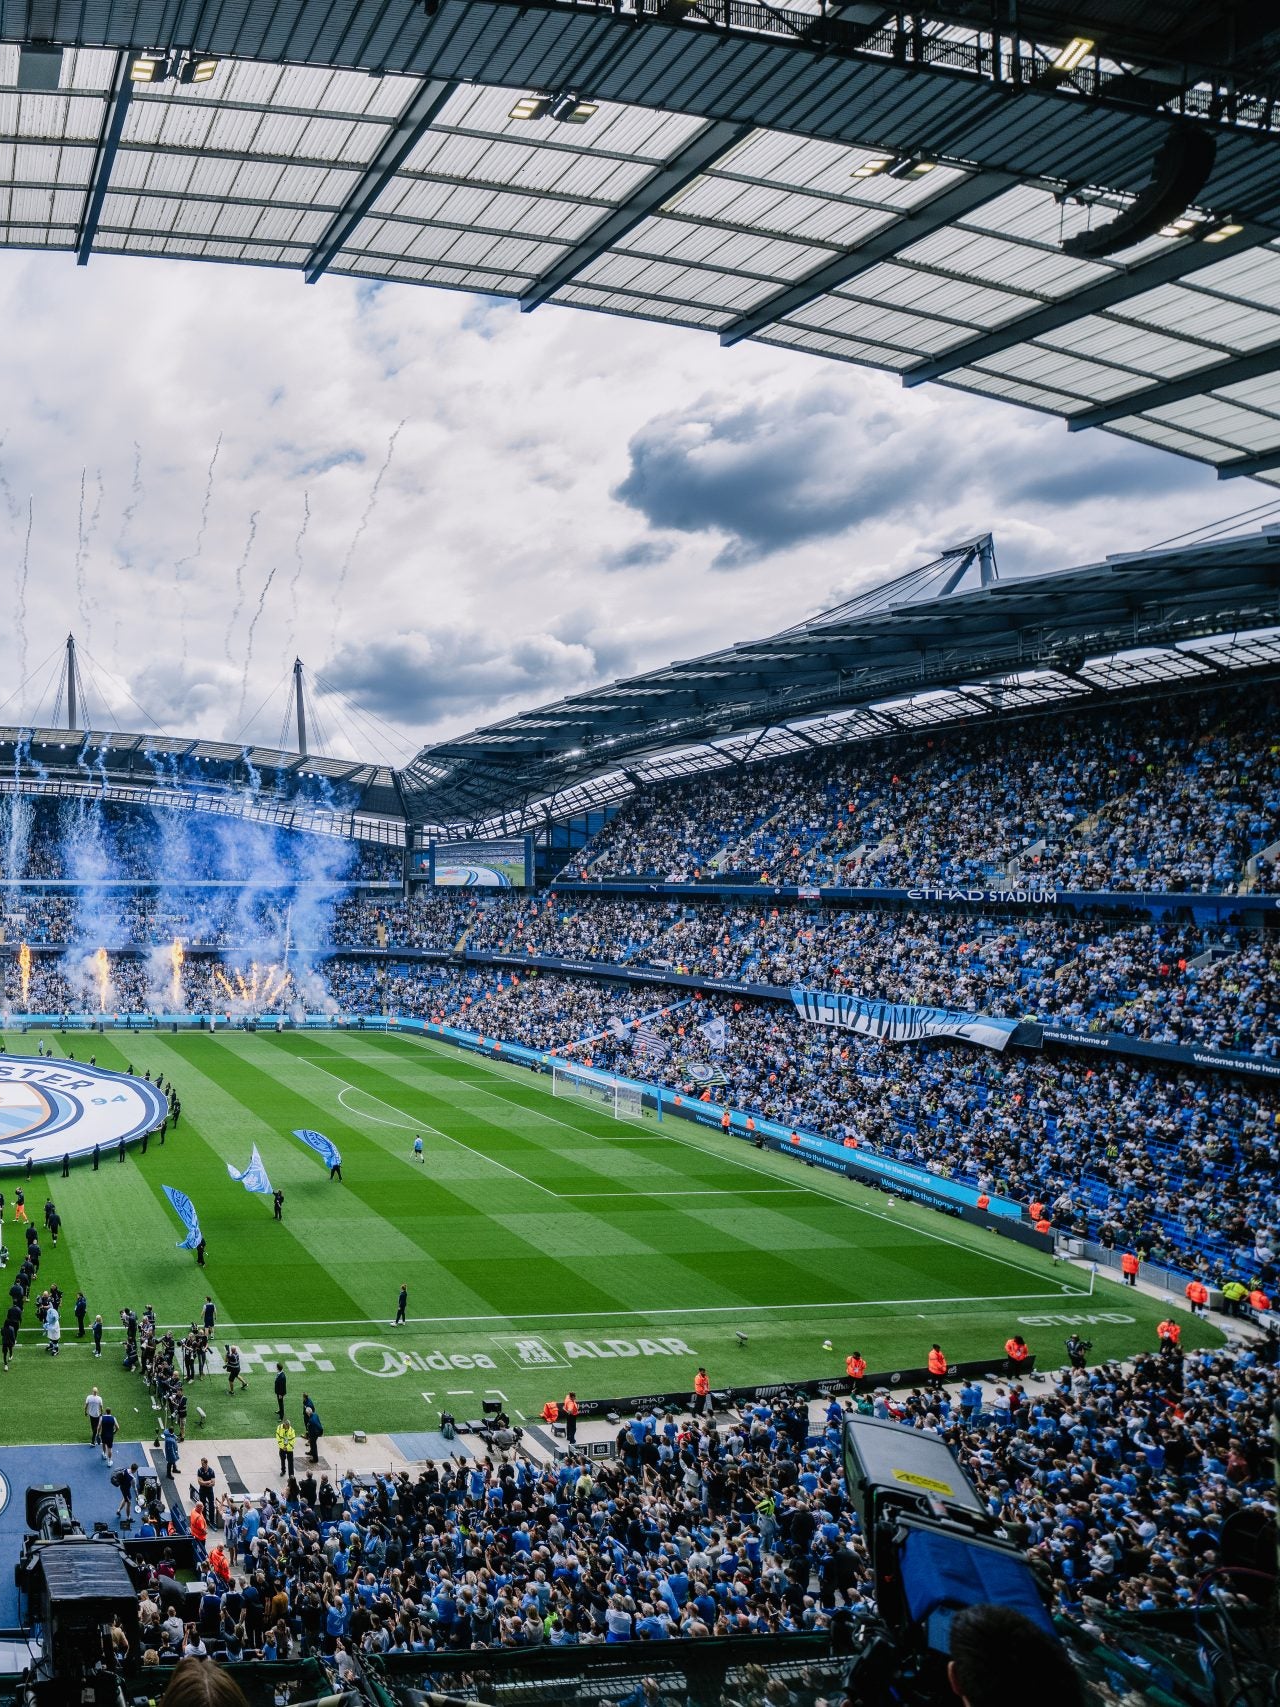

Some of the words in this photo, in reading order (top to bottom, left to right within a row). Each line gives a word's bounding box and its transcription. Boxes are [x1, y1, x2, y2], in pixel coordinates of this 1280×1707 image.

[907, 890, 984, 901] ETIHAD
[989, 891, 1057, 903] STADIUM
[1068, 1034, 1079, 1042] the
[1080, 1036, 1100, 1044] home
[1193, 1053, 1234, 1066] Welcome
[1234, 1059, 1244, 1068] to
[1245, 1061, 1261, 1071] the
[90, 1094, 129, 1106] 94
[780, 1143, 806, 1158] Welcome
[812, 1154, 822, 1163] the
[822, 1156, 839, 1168] home
[839, 1162, 847, 1171] of
[855, 1153, 885, 1168] Welcome
[892, 1165, 904, 1173] the
[903, 1169, 922, 1181] home
[912, 1189, 920, 1198] to
[920, 1193, 933, 1203] the
[1017, 1313, 1136, 1327] ETIHAD
[563, 1338, 698, 1358] ALDAR
[360, 1347, 497, 1374] Midea
[630, 1396, 665, 1405] ETIHAD
